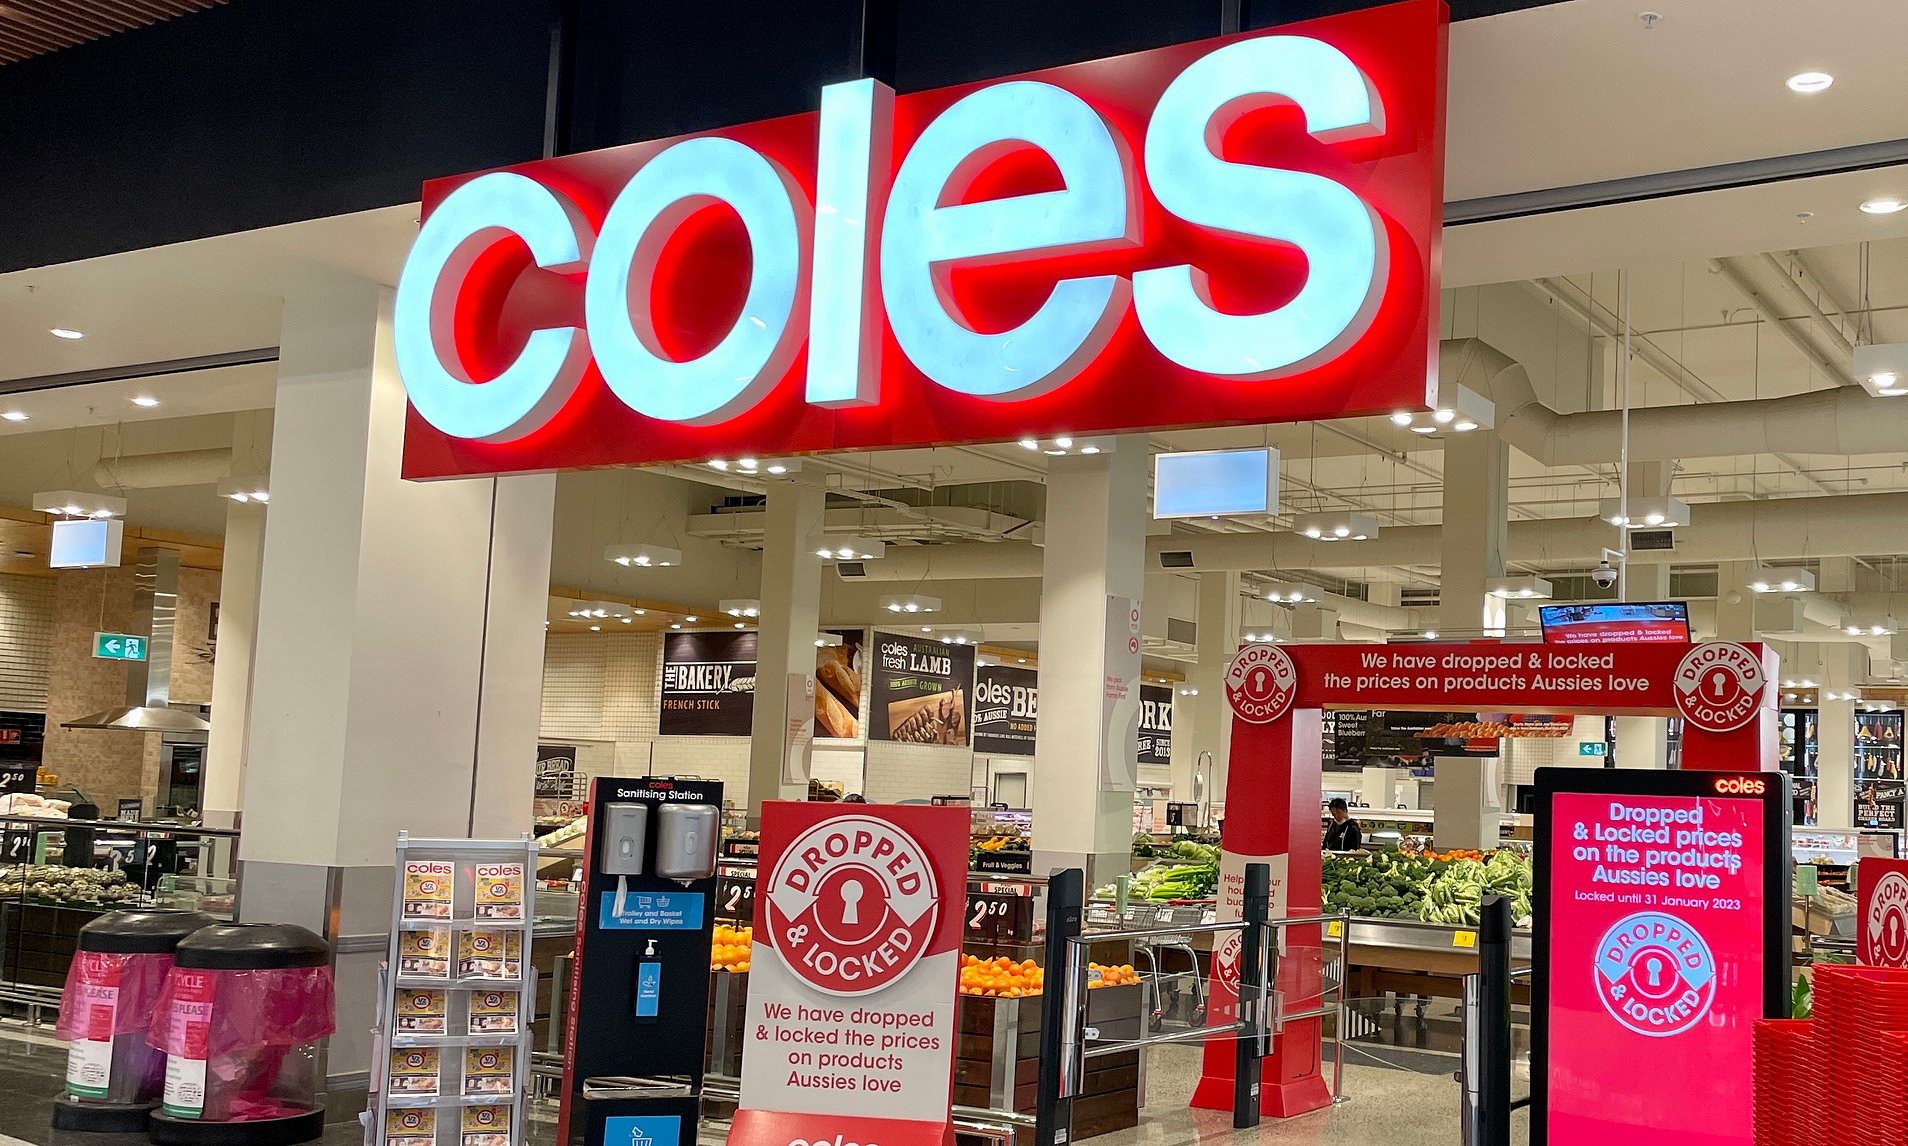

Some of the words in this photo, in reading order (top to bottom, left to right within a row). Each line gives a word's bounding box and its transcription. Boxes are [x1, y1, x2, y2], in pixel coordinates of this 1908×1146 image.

[393, 34, 1385, 442] coles
[1599, 630, 1635, 638] dropped
[881, 641, 908, 657] coles
[912, 643, 950, 657] AUSTRALIAN
[882, 654, 906, 670] fresh
[910, 653, 951, 676] LAMB
[1231, 649, 1289, 679] DROPPED
[1361, 653, 1387, 669] We
[1392, 653, 1436, 669] have
[1441, 653, 1521, 672] dropped
[1528, 653, 1542, 669] &
[1548, 652, 1613, 669] locked
[1682, 647, 1757, 681] DROPPED
[665, 666, 676, 689] THE
[677, 664, 733, 691] BAKERY
[919, 681, 943, 692] GROWN
[1323, 673, 1351, 689] the
[1356, 673, 1410, 692] prices
[1415, 675, 1438, 689] on
[1443, 672, 1526, 693] products
[1531, 672, 1603, 691] Aussies
[1608, 673, 1650, 691] love
[663, 700, 695, 710] FRENCH
[696, 700, 720, 710] STICK
[1232, 691, 1243, 703] &
[1239, 692, 1286, 717] LOCKED
[1684, 694, 1698, 708] &
[983, 709, 1008, 722] AUSSIE
[1337, 712, 1355, 722] 100%
[1694, 695, 1754, 724] LOCKED
[1337, 721, 1359, 730] Sweet
[616, 788, 667, 801] Sanitising
[668, 790, 704, 800] Station
[648, 781, 673, 790] coles
[1714, 777, 1765, 795] coles
[1609, 802, 1703, 825] Dropped
[1572, 822, 1588, 840] &
[1595, 823, 1670, 844] Locked
[1676, 829, 1743, 849] prices
[785, 830, 922, 896] DROPPED
[982, 861, 995, 869] Fruit
[1000, 862, 1022, 870] Veggies
[1573, 846, 1600, 862] on
[1605, 844, 1640, 864] the
[1645, 846, 1742, 870] products
[407, 862, 452, 875] coles
[477, 864, 521, 877] coles
[1592, 864, 1670, 886] Aussies
[1675, 868, 1721, 890] love
[994, 886, 1017, 895] SPECIAL
[1574, 890, 1615, 902] Locked
[1617, 892, 1642, 904] until
[1644, 893, 1658, 905] 31
[1661, 895, 1709, 911] January
[1712, 898, 1741, 911] 2023
[649, 918, 661, 926] Dry
[663, 918, 684, 926] Wipes
[786, 923, 809, 949] &
[1606, 922, 1703, 969] DROPPED
[802, 926, 913, 981] LOCKED
[1610, 984, 1627, 1001] &
[763, 1002, 792, 1020] We
[798, 1004, 844, 1023] have
[850, 1007, 935, 1030] dropped
[1622, 988, 1701, 1025] LOCKED
[755, 1024, 769, 1041] &
[775, 1026, 839, 1045] locked
[844, 1029, 875, 1047] the
[881, 1033, 940, 1051] prices
[788, 1051, 812, 1066] on
[818, 1051, 904, 1071] products
[786, 1070, 857, 1091] Aussies
[862, 1074, 902, 1093] love
